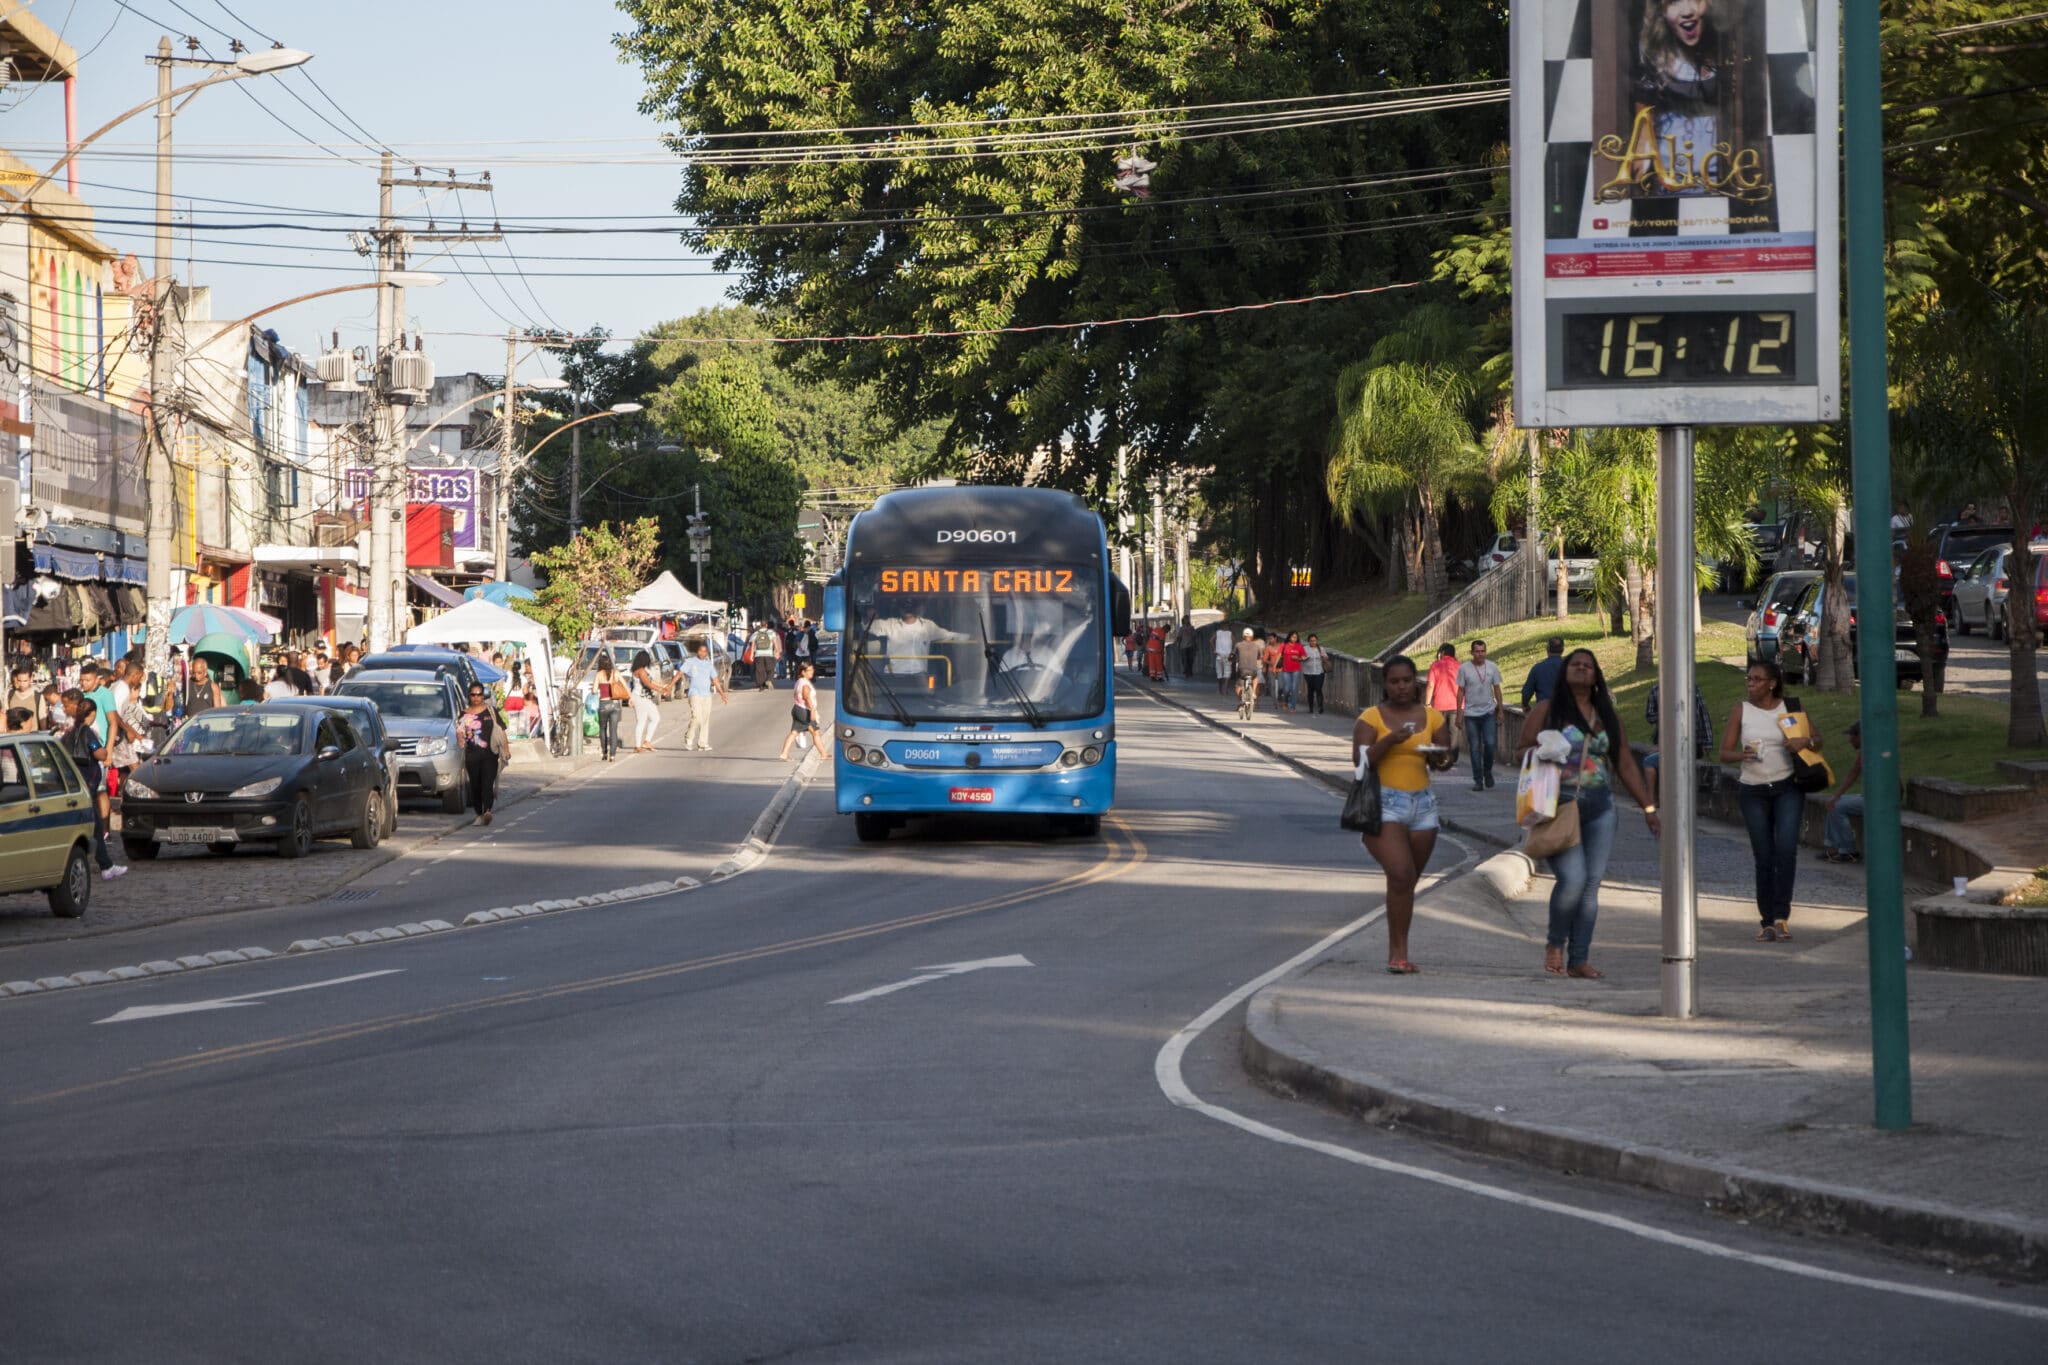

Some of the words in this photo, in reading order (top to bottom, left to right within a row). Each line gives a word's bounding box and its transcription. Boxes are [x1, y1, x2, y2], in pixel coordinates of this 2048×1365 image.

[1594, 105, 1773, 204] Alice
[1600, 313, 1791, 377] 16:12
[936, 529, 1017, 543] D90601
[882, 570, 980, 592] SANTA
[993, 570, 1073, 592] CRUZ
[904, 748, 940, 760] D90601
